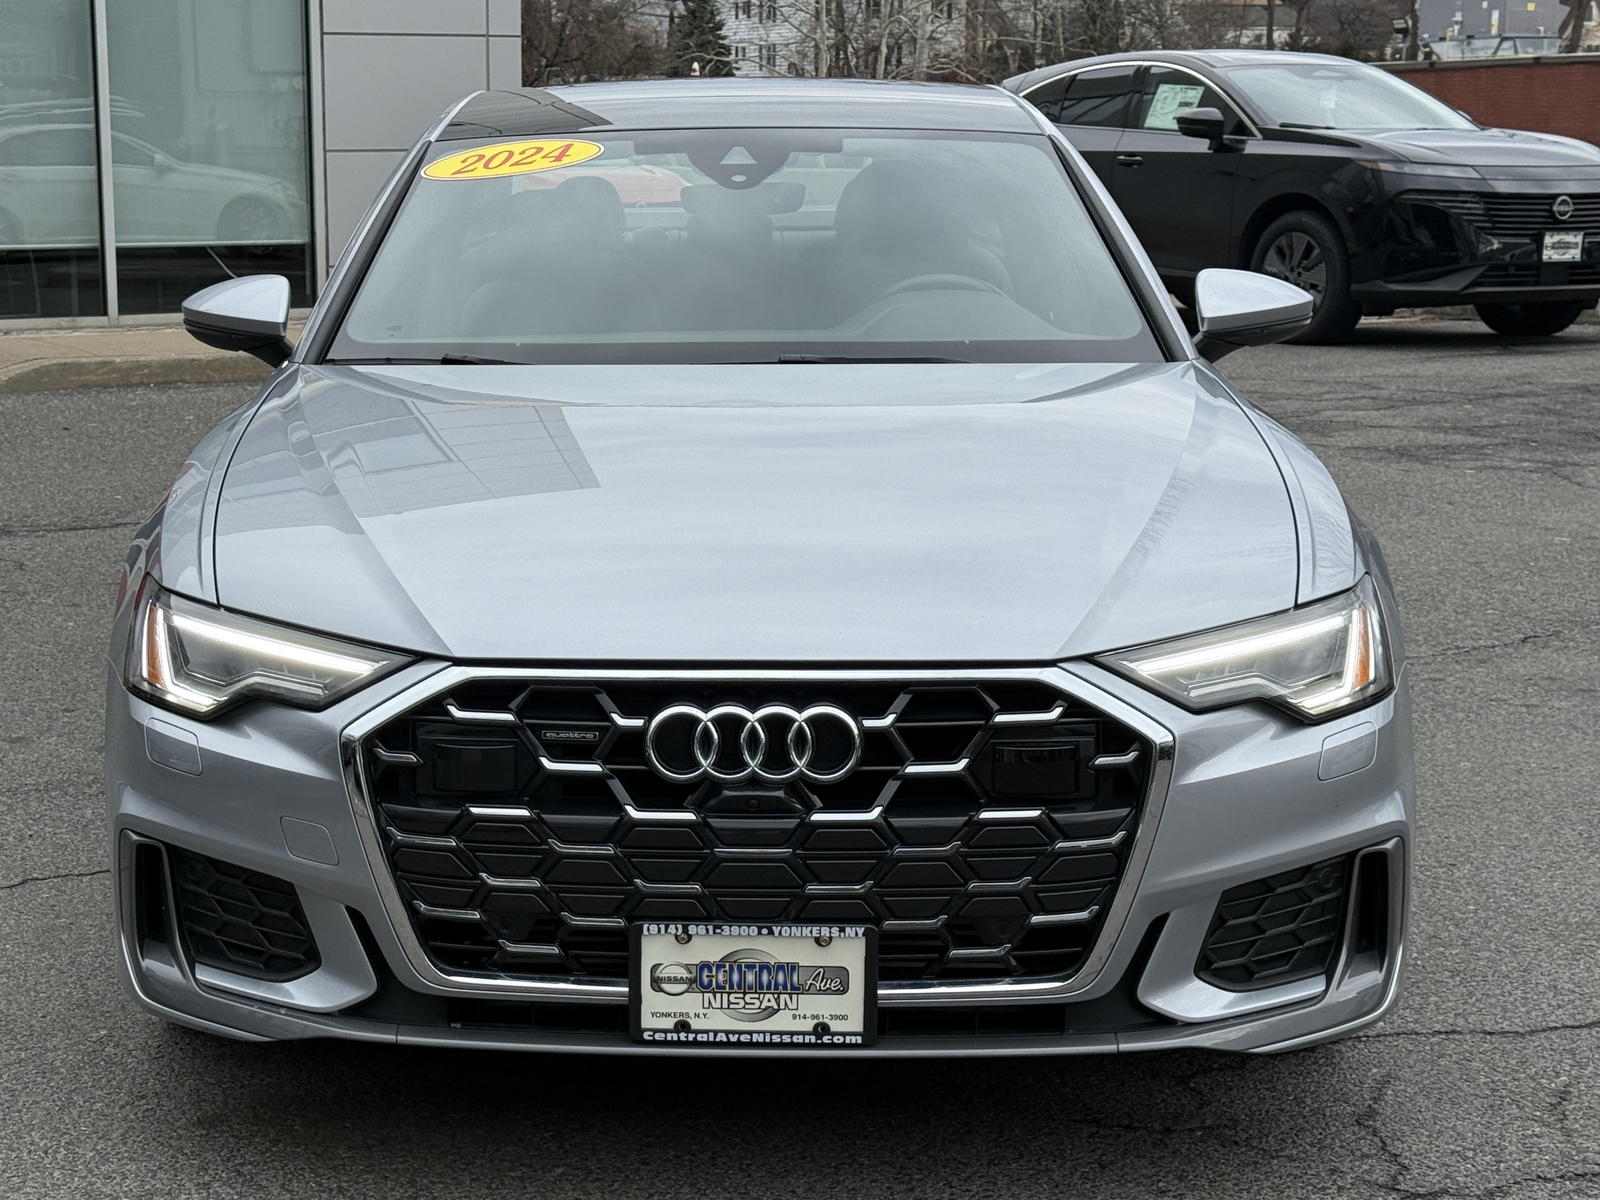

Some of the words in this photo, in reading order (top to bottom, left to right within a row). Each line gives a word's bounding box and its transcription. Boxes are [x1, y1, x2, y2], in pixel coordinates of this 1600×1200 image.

[451, 143, 575, 176] 2024
[688, 926, 758, 936] 961-3900
[772, 926, 865, 938] YONKERS,NY
[656, 975, 693, 983] NISSAN
[696, 961, 803, 993] CENTRAL
[804, 967, 844, 991] Ave.
[702, 992, 799, 1010] NISSAN
[650, 1011, 692, 1020] YONKERS,
[693, 1012, 710, 1020] N.Y.
[791, 1013, 849, 1021] 914-961-3900
[643, 1030, 862, 1044] CentralAveNissan.com
